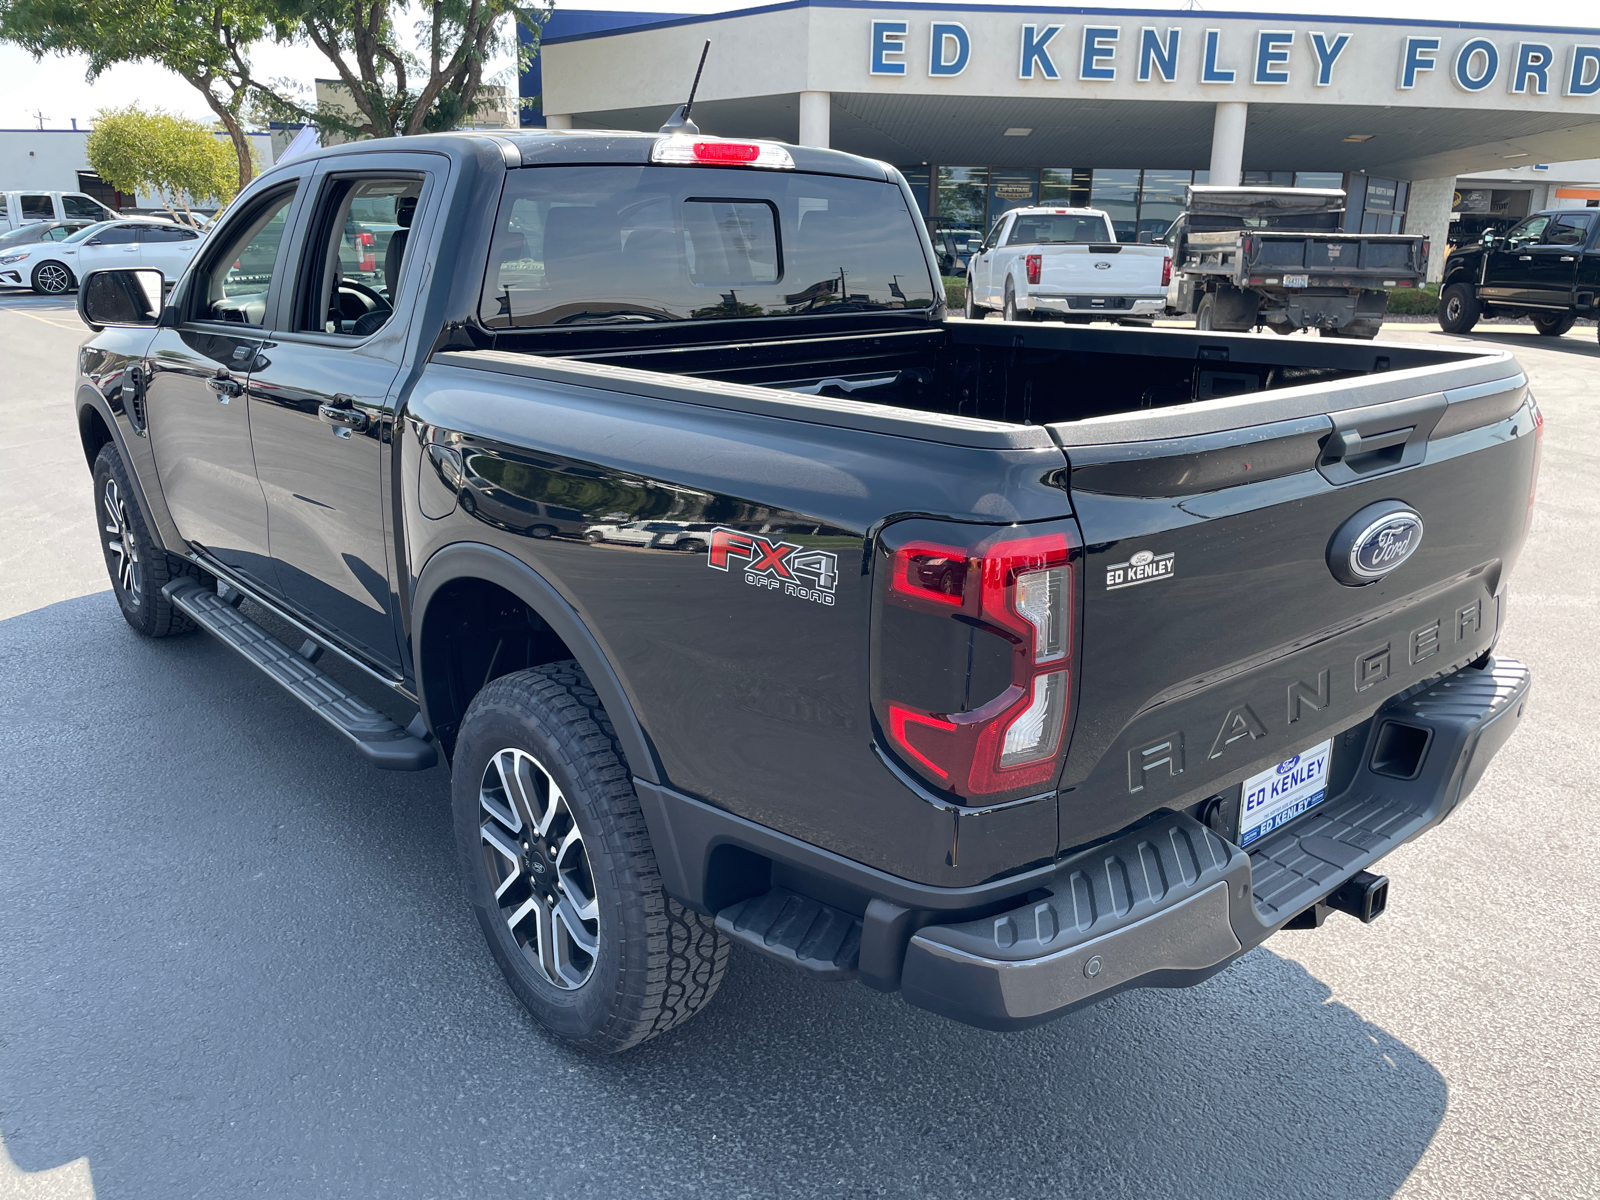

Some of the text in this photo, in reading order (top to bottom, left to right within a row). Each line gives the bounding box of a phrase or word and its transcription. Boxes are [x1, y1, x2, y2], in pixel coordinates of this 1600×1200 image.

[870, 19, 1600, 97] ED KENLEY FORD
[707, 526, 839, 593] FX4
[1135, 553, 1149, 565] Ford
[1371, 526, 1413, 565] Ford
[744, 572, 836, 606] OFF ROAD
[1106, 558, 1174, 585] ED KENLEY
[1127, 598, 1482, 795] RANGER
[1246, 756, 1325, 812] ED KENLEY
[1280, 757, 1298, 773] Ford
[1260, 820, 1274, 836] ED
[1275, 797, 1311, 827] KENLEY
